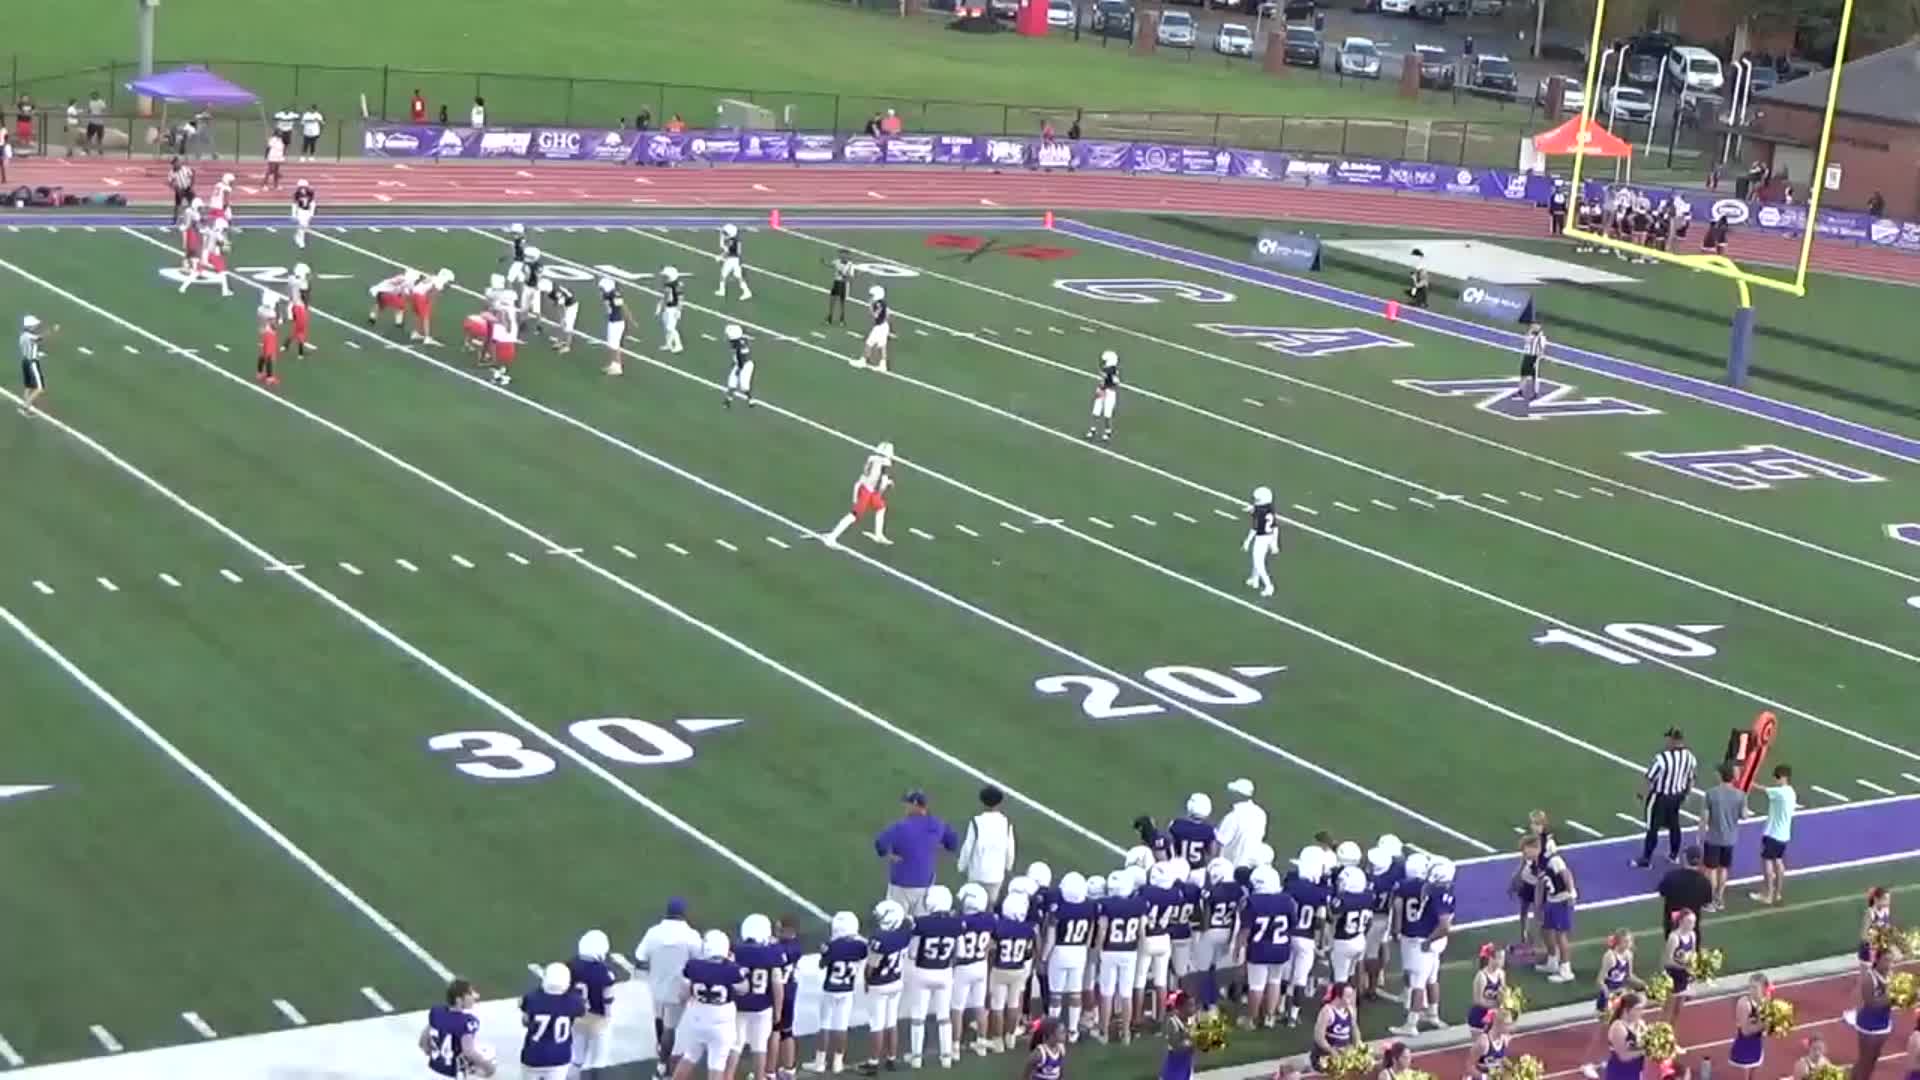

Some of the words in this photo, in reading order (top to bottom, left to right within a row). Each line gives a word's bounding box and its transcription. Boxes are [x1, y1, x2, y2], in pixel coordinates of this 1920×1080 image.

[539, 132, 580, 149] GHC
[1533, 622, 1717, 665] 10
[1034, 665, 1263, 719] 20
[428, 716, 695, 779] 30
[1064, 919, 1089, 943] 10
[1253, 915, 1289, 944] 72
[923, 936, 955, 960] 53
[999, 938, 1027, 963] 30
[531, 1013, 571, 1045] 70
